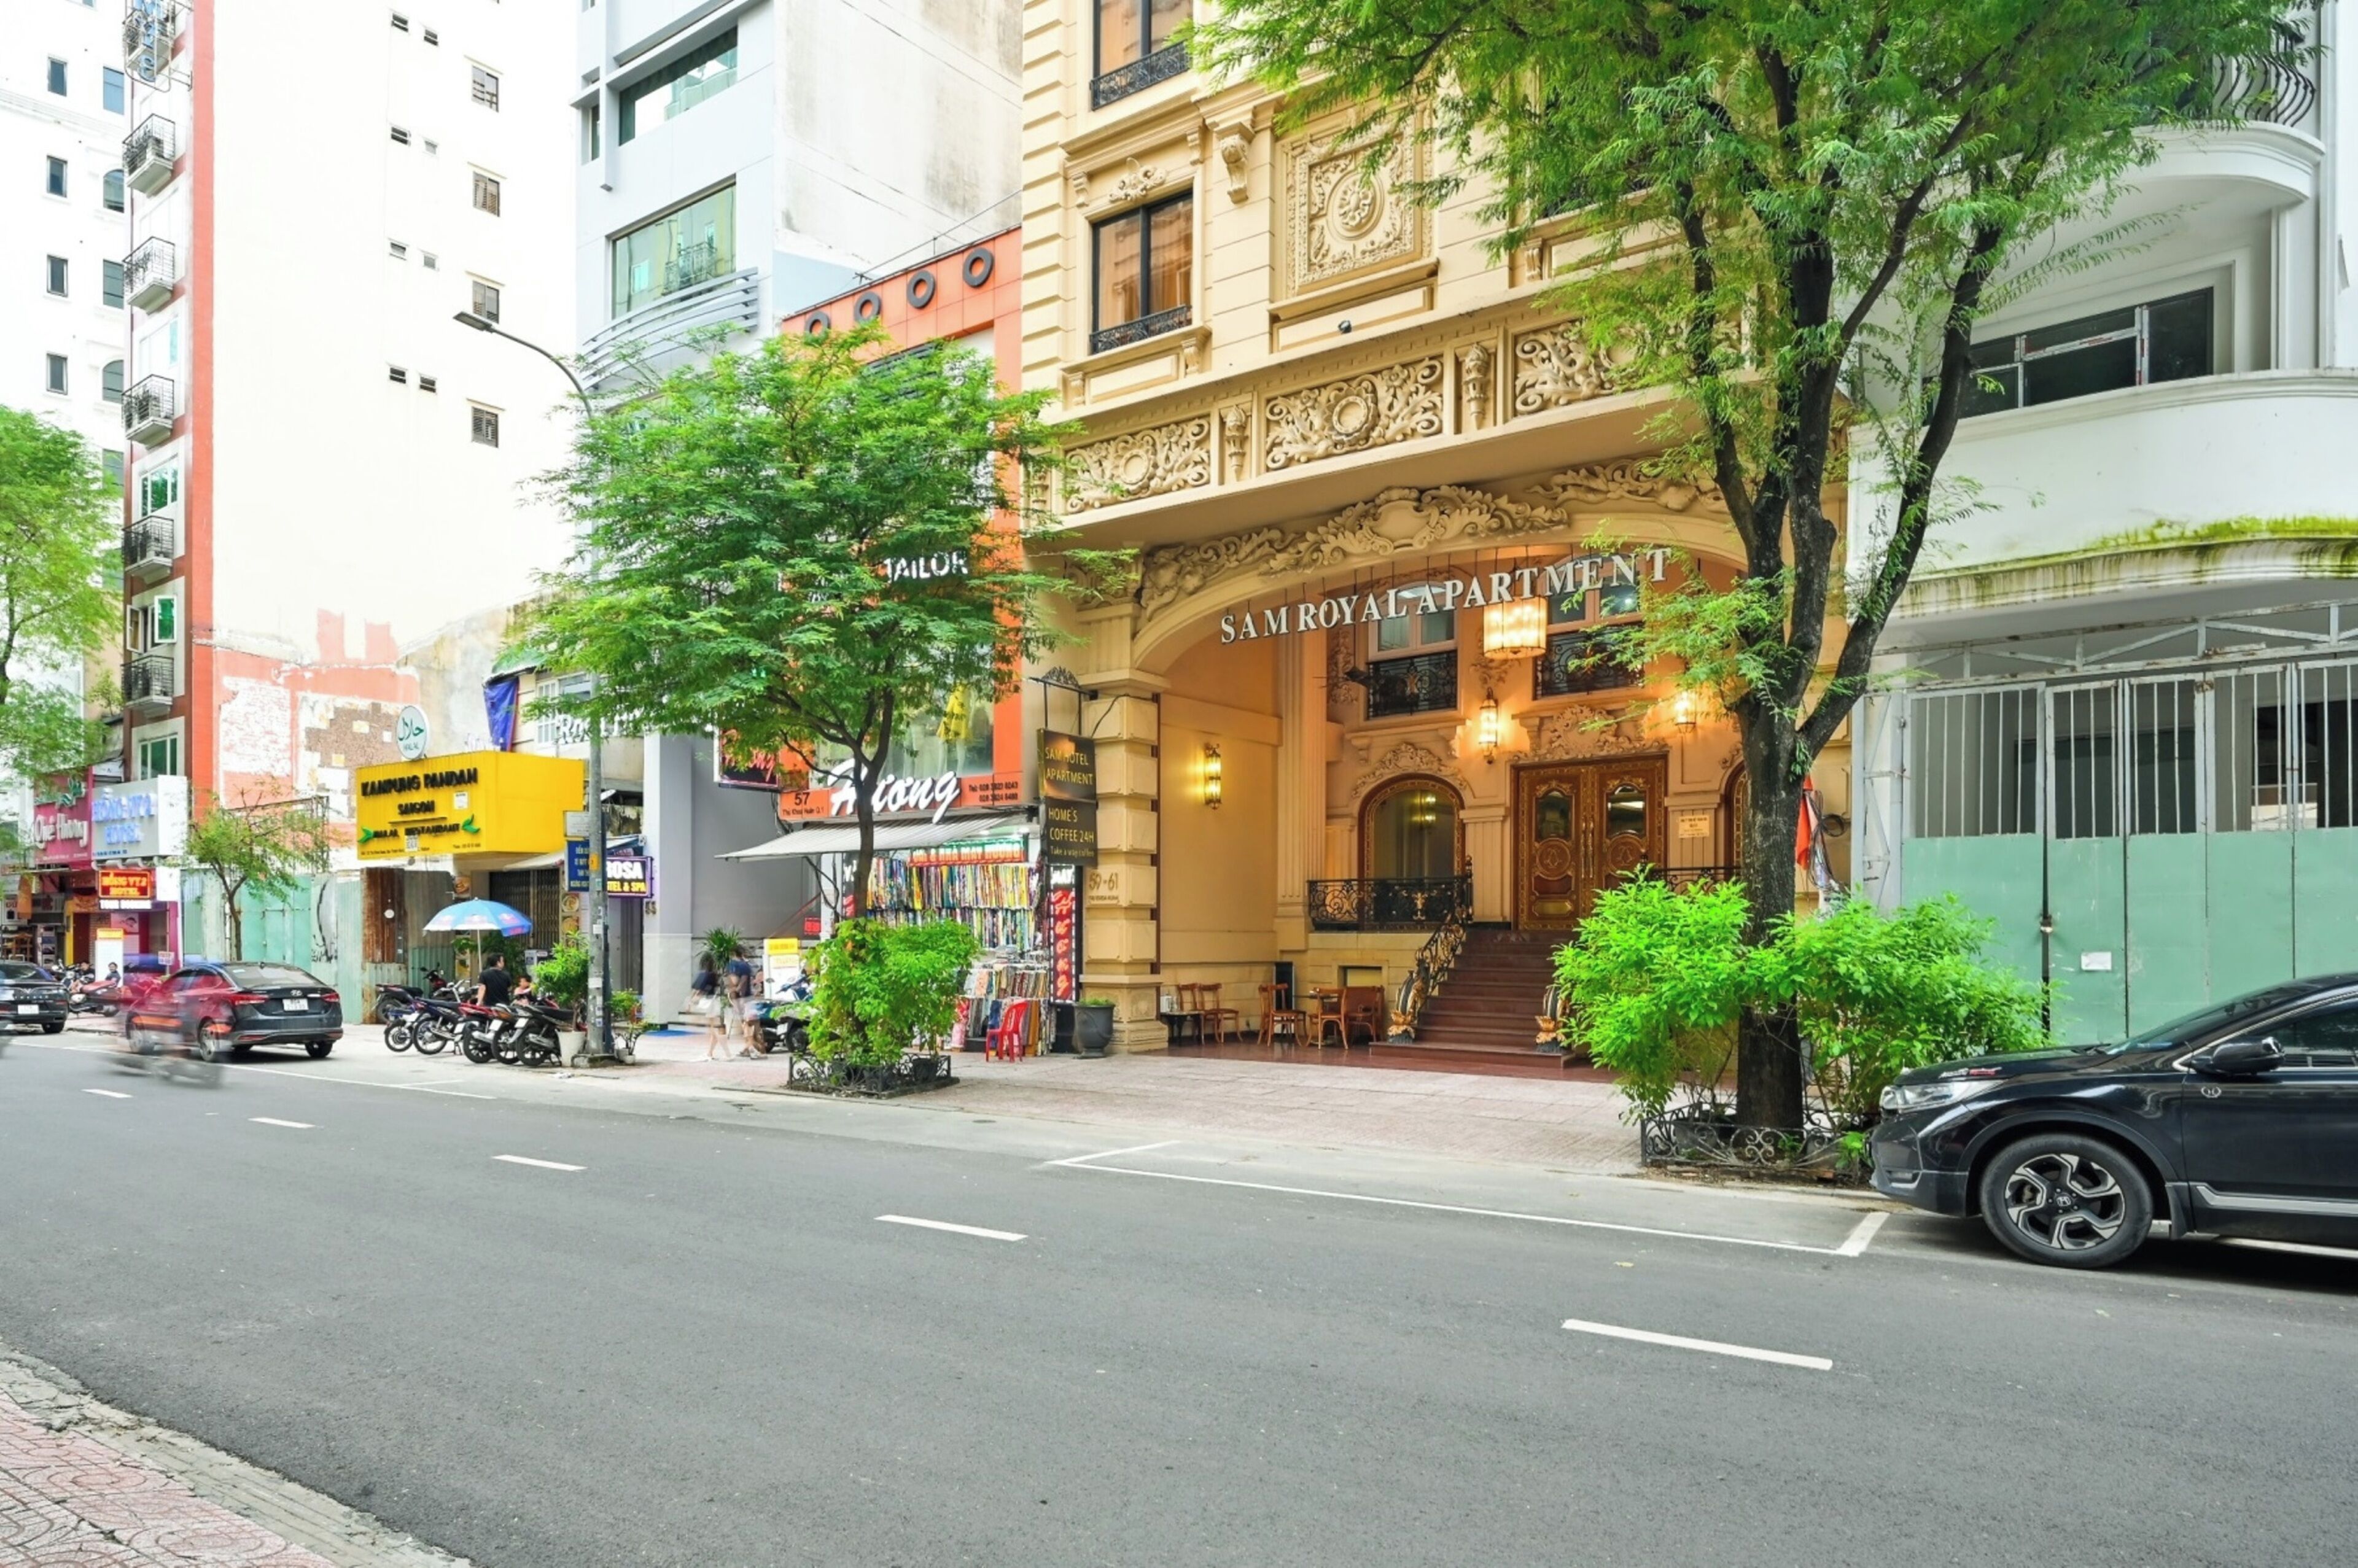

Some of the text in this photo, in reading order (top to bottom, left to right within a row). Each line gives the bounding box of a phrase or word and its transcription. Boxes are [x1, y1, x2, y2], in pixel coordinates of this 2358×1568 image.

[883, 550, 968, 583] TAILOR
[1220, 548, 1673, 645] SAM ROYAL APARTMENT
[398, 716, 424, 741] حلال
[1045, 747, 1089, 766] SAM HOTEL
[361, 767, 478, 797] KAMPUNG PANDAN
[1046, 767, 1093, 785] APARTMENT
[397, 800, 435, 816] SAIGON
[795, 792, 810, 806] 57
[1050, 827, 1094, 844] COFFEE 24H
